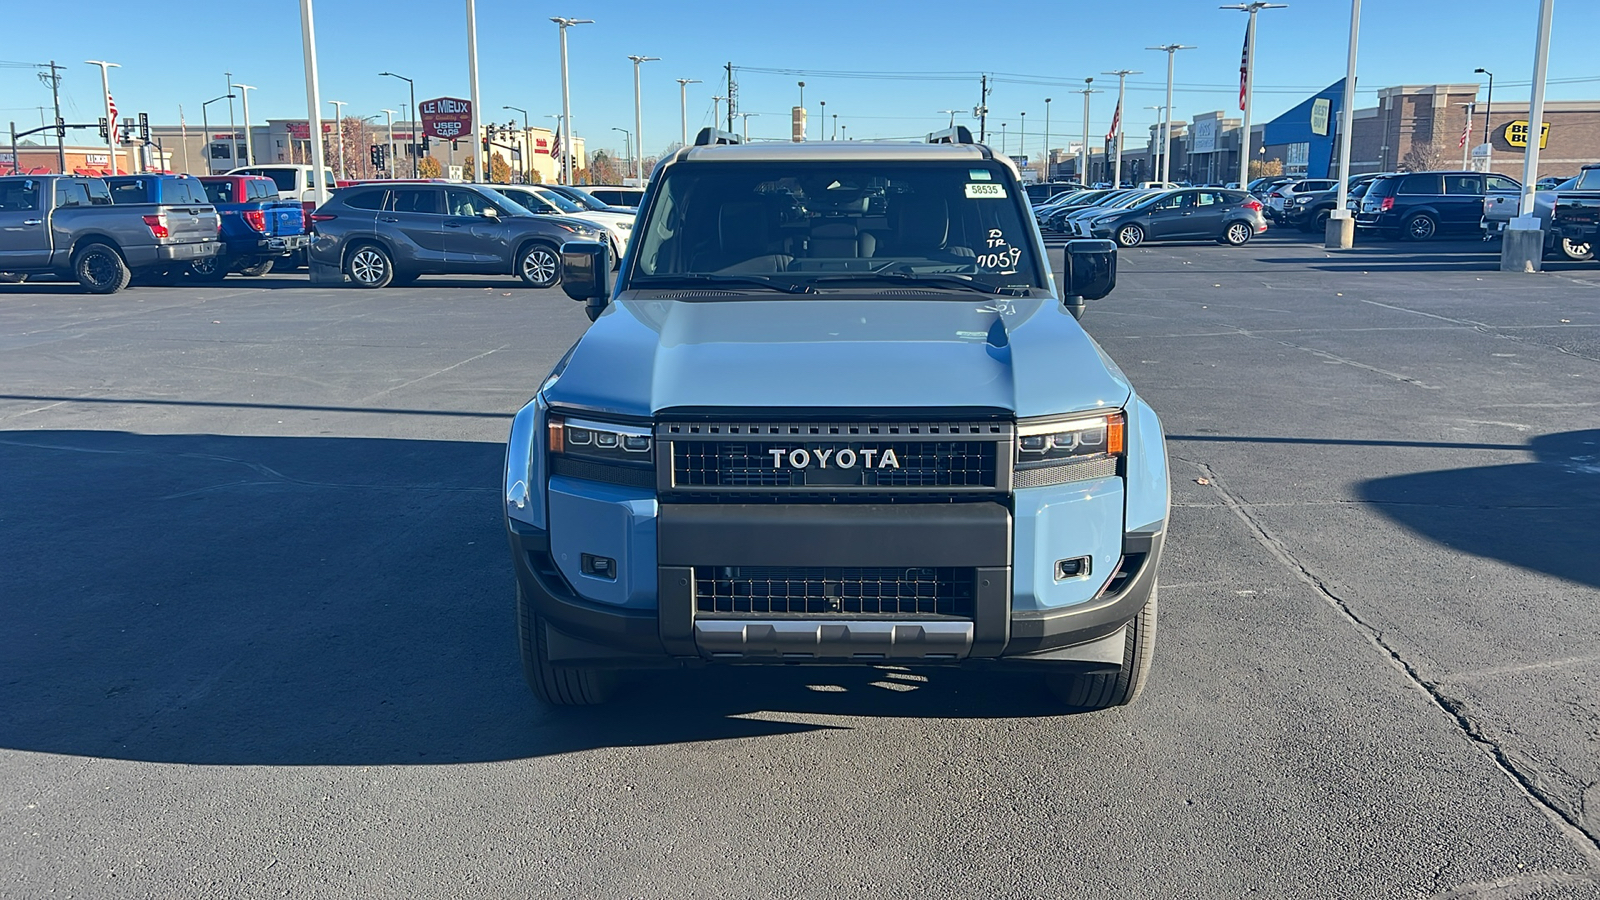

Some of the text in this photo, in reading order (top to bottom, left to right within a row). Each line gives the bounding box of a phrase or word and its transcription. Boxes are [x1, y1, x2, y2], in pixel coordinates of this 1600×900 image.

[423, 99, 468, 114] LE MIEUX
[1314, 104, 1328, 117] BEST
[1313, 116, 1326, 129] BUY
[436, 128, 460, 137] CARS
[1511, 124, 1548, 135] BET
[971, 185, 998, 195] 58535
[986, 239, 1007, 248] TR
[768, 448, 900, 469] TOYOTA
